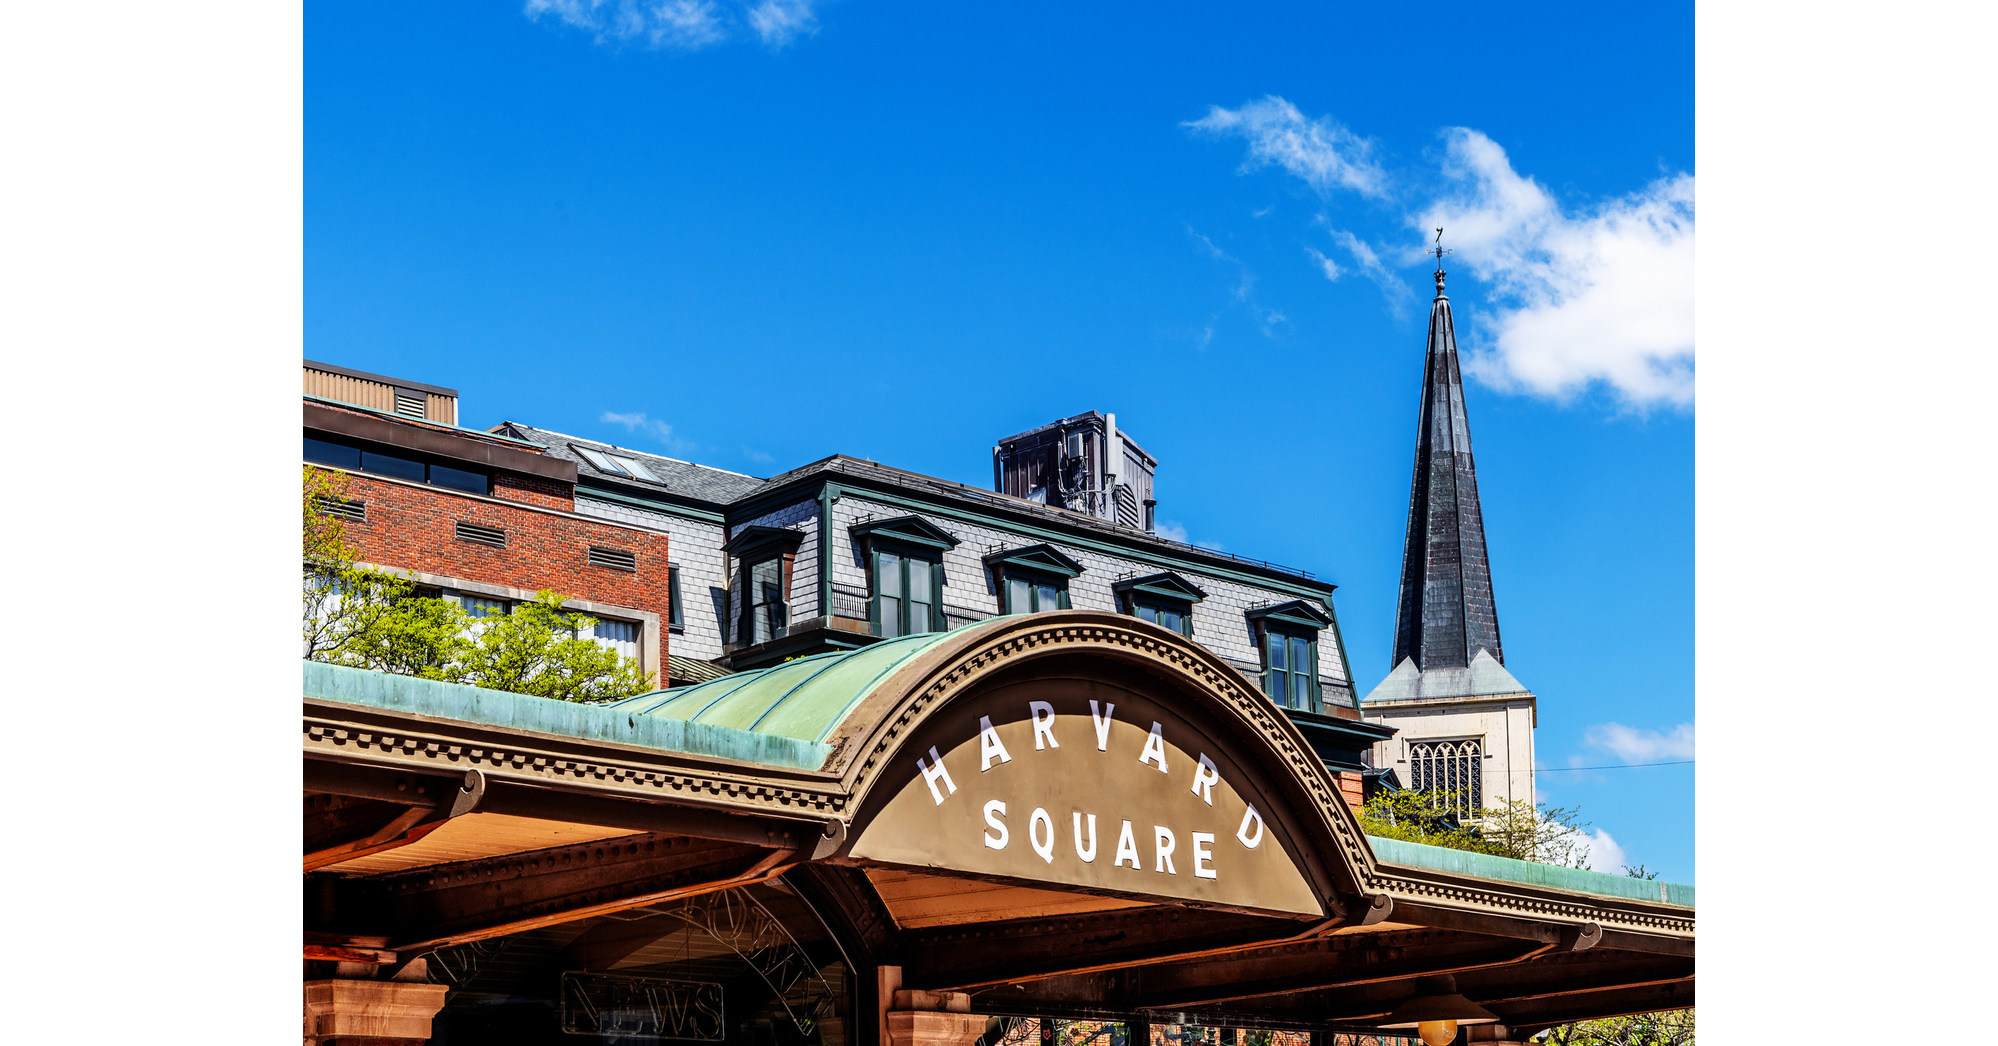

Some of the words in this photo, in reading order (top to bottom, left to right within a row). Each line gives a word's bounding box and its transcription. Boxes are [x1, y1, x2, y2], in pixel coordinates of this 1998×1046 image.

[916, 699, 1264, 849] HARVARD
[983, 799, 1217, 880] SQUARE
[566, 977, 721, 1037] NEWS
